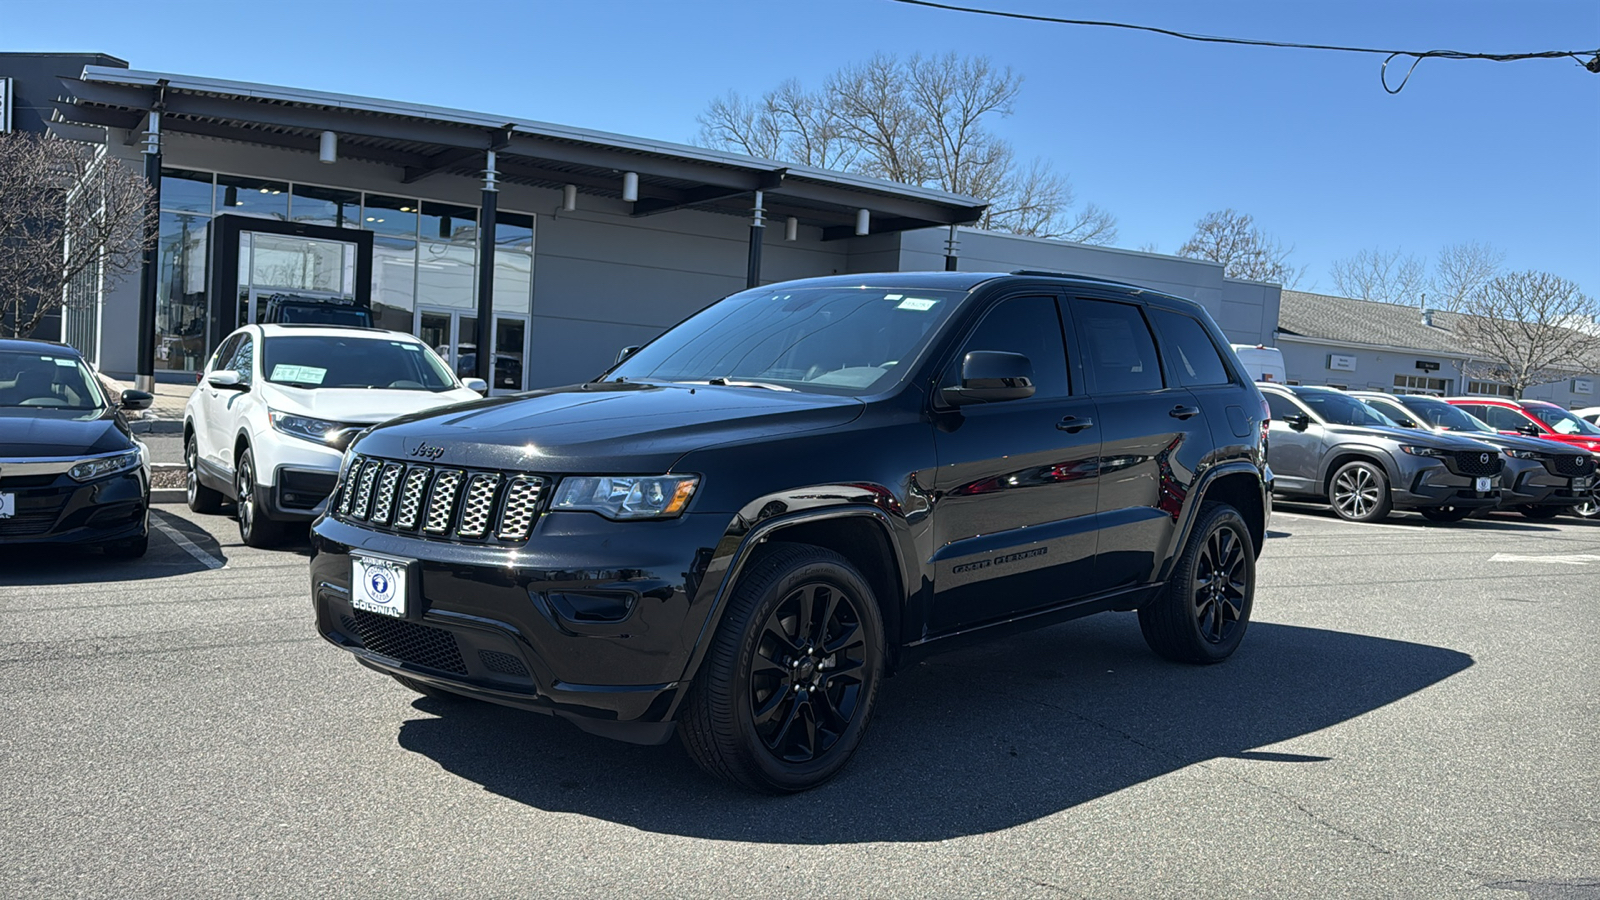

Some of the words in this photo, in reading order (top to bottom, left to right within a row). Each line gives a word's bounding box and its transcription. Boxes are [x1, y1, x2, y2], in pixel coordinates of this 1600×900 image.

[411, 441, 445, 461] Jeep
[952, 559, 992, 574] GRAND
[993, 546, 1048, 566] CHEROKEE
[353, 600, 400, 618] COLONIAL
[740, 601, 769, 679] COOPER
